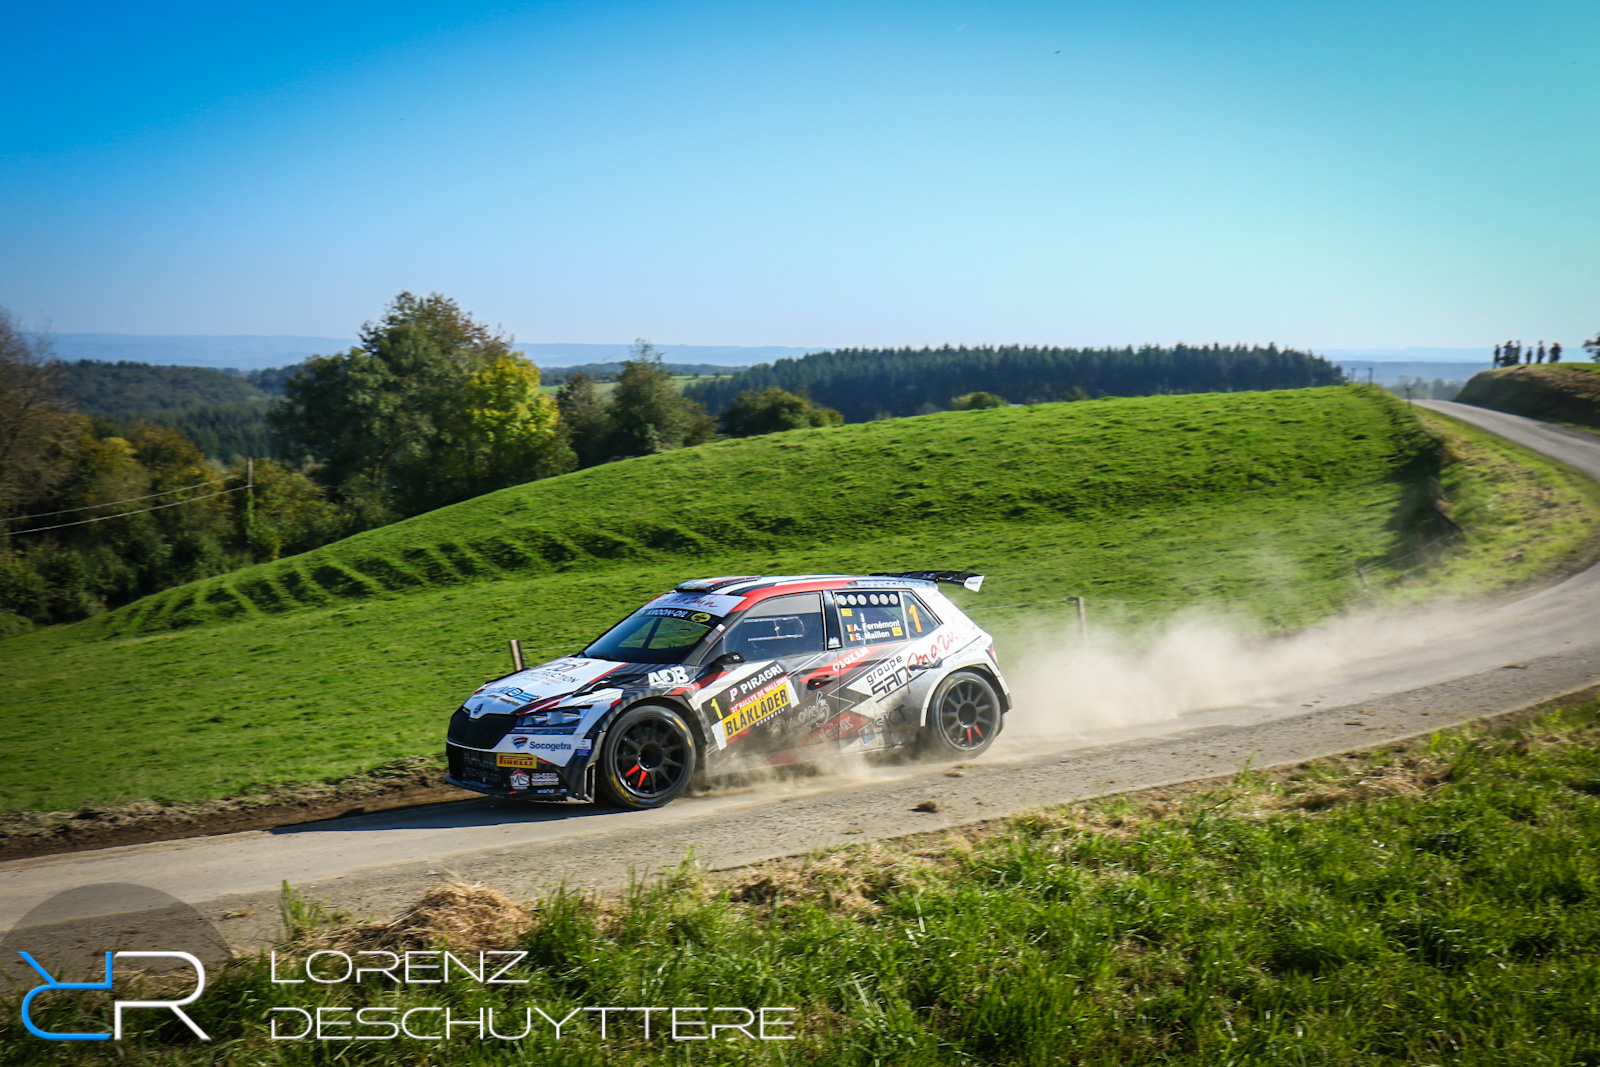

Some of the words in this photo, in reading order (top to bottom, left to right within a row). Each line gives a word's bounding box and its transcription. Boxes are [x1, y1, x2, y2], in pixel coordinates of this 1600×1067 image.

[908, 604, 922, 633] 1
[740, 664, 784, 694] PIRAGRI
[866, 655, 903, 685] groupe
[710, 698, 723, 720] 1
[725, 688, 788, 736] BLÅKLÄDER
[738, 695, 758, 709] RALLYE
[529, 741, 572, 752] Socogetra
[499, 755, 534, 766] PIRELLI
